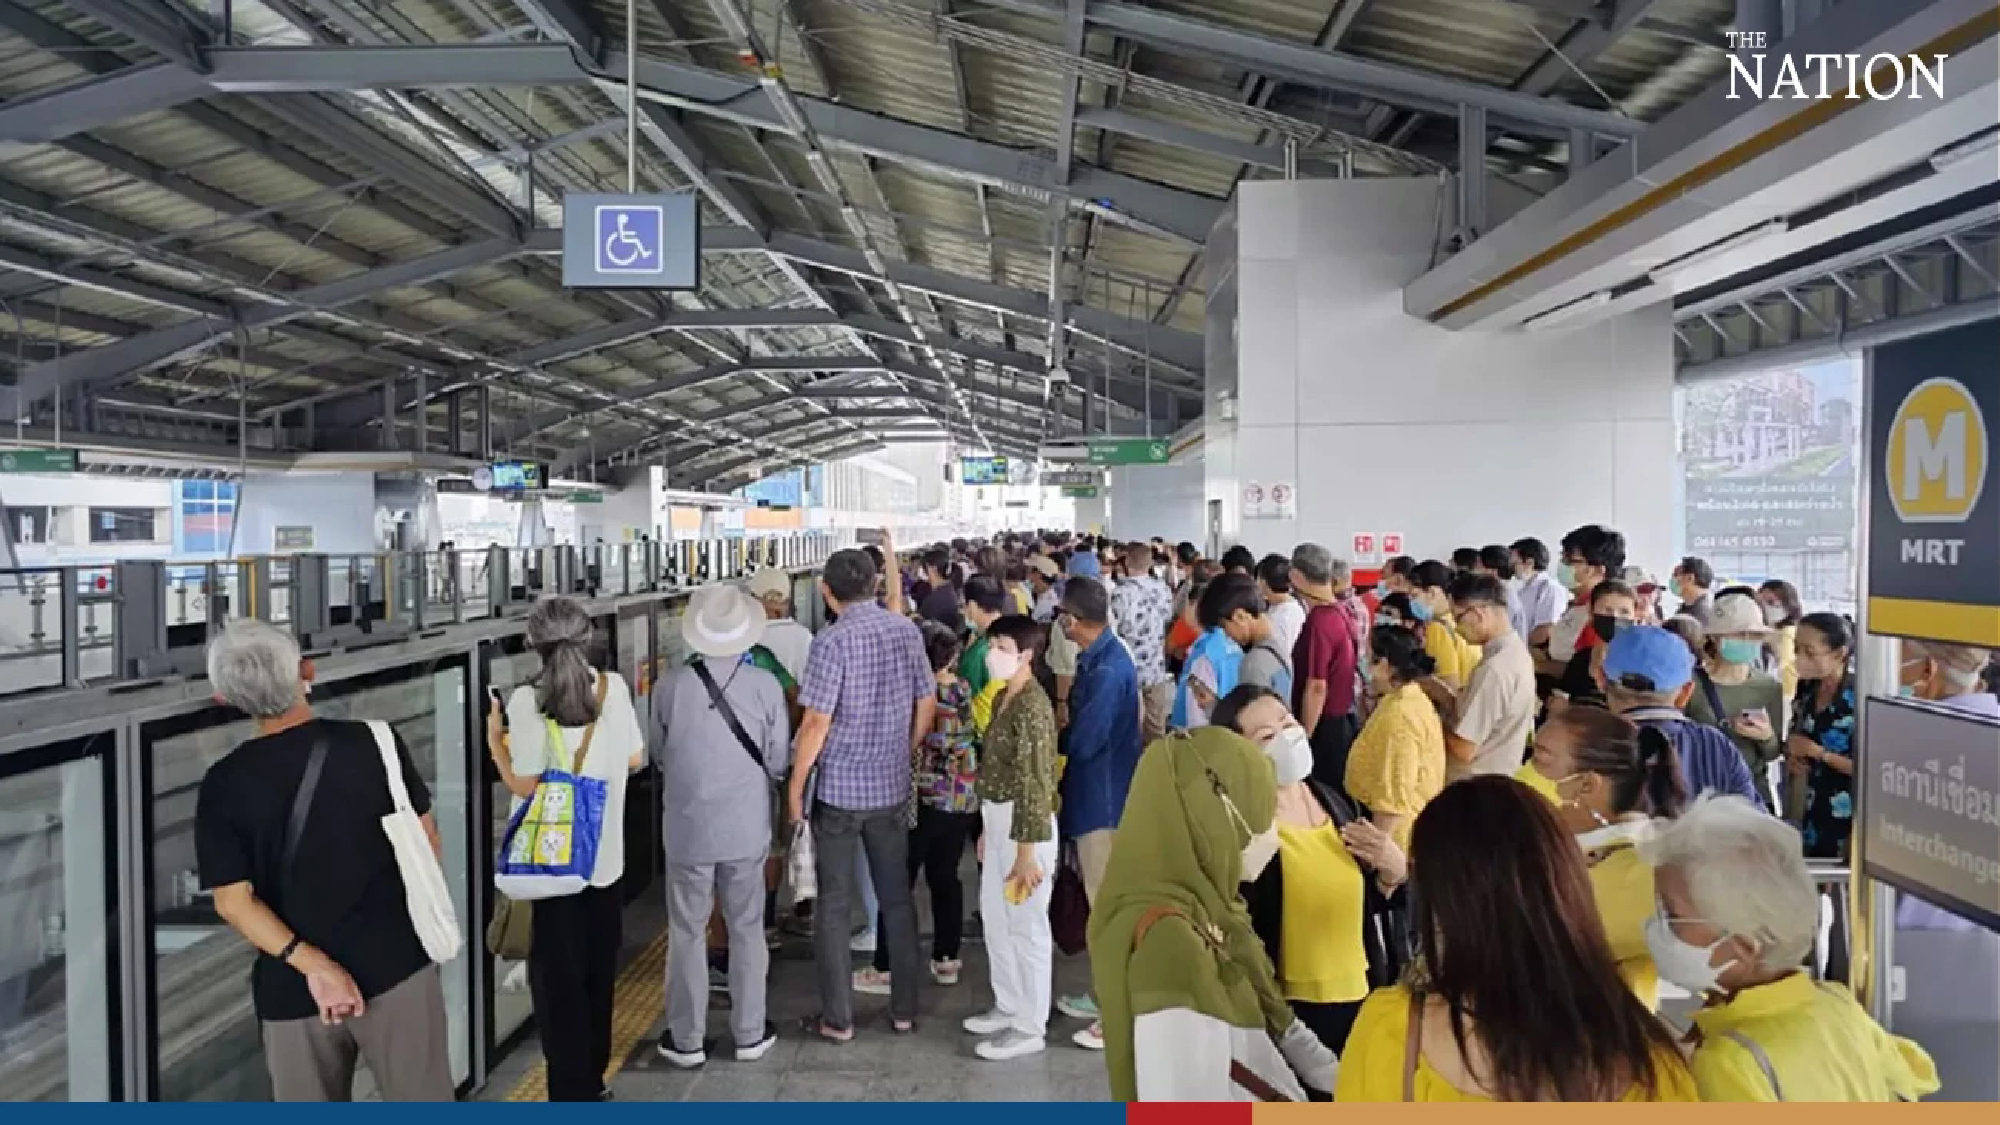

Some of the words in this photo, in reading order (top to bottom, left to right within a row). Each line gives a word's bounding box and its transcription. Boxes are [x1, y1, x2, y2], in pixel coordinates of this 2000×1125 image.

[1903, 411, 1966, 501] M
[1901, 538, 1966, 566] MRT
[1881, 813, 2000, 885] Interchange
